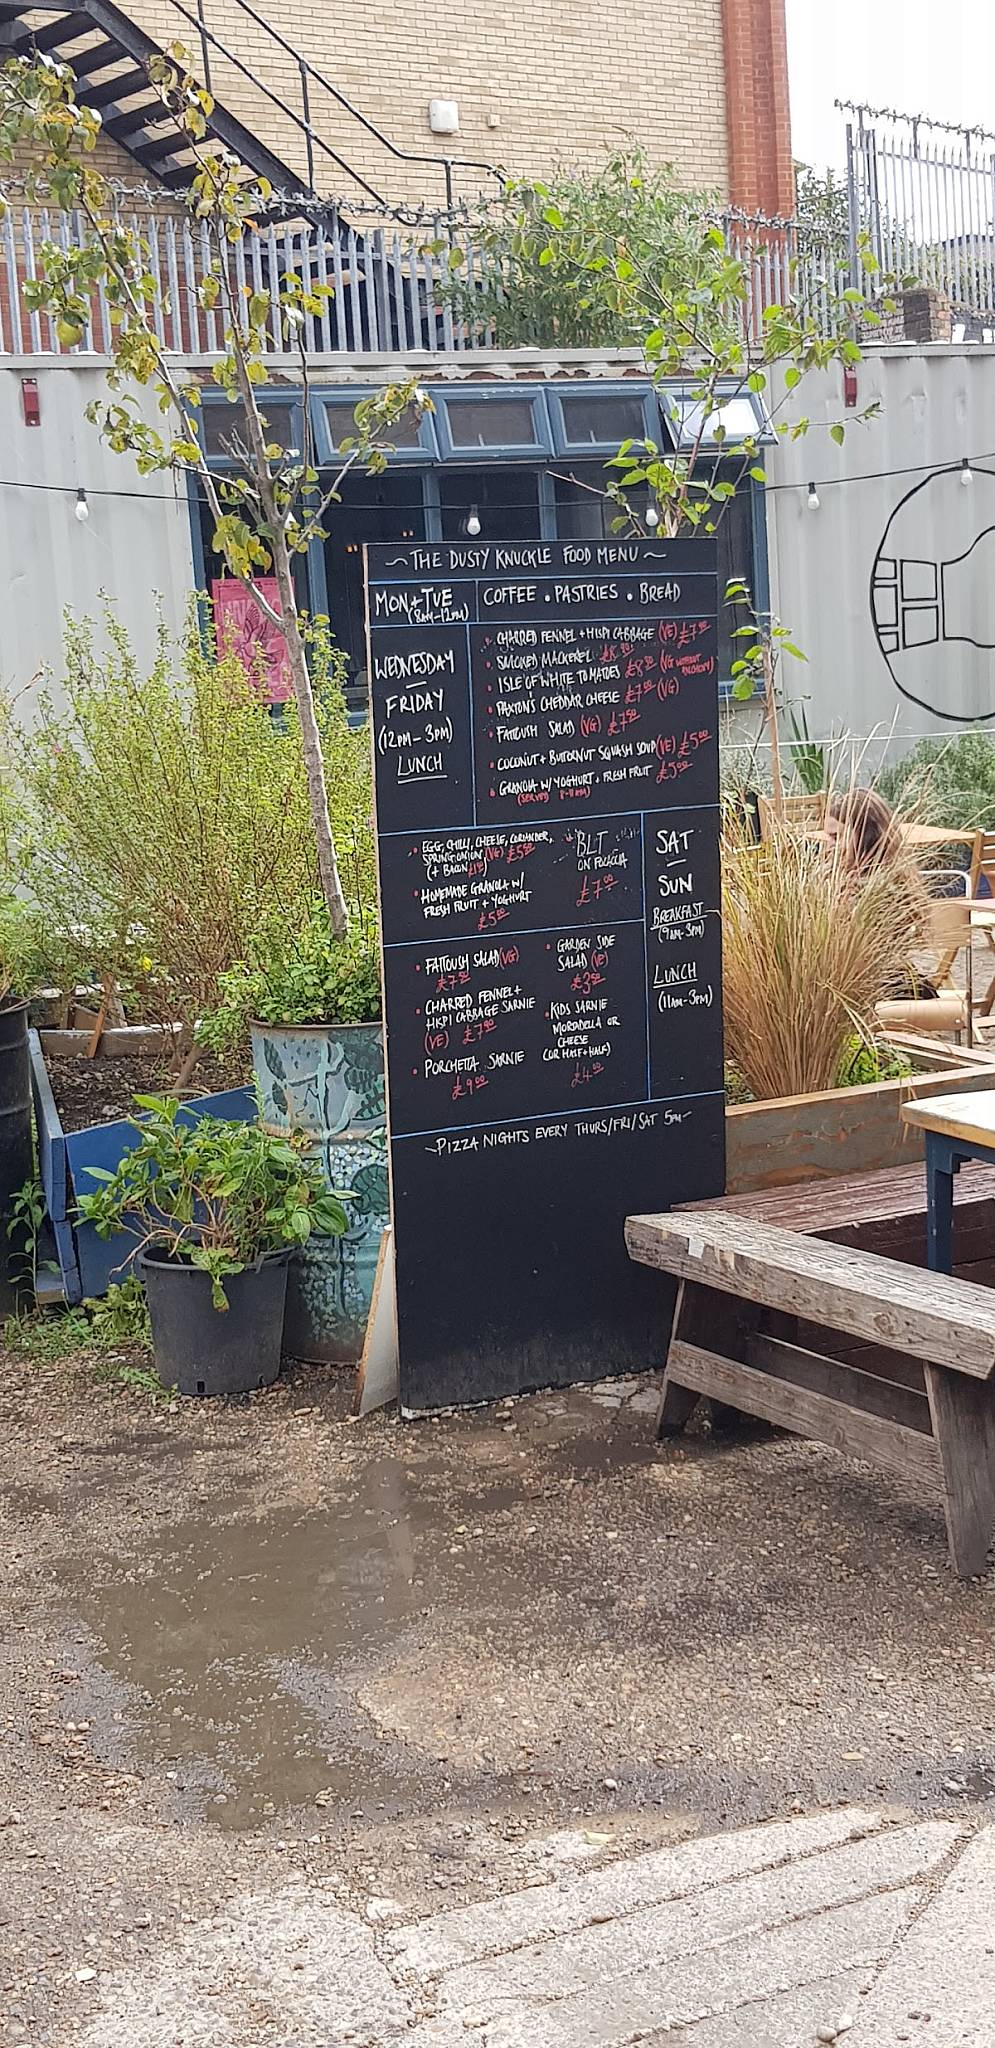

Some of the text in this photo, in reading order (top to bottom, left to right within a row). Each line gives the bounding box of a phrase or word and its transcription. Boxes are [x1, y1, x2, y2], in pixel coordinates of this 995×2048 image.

[409, 547, 638, 570] THE DUSTY KNUCKLE FOOD MENU
[483, 583, 681, 606] COFFEE PASTRIES BREAD
[496, 630, 537, 647] CHARRED
[541, 629, 577, 644] FENNEL
[612, 626, 655, 642] CABBAGE
[658, 620, 678, 644] (VE)
[375, 649, 454, 680] WEDNESDAY
[541, 648, 593, 669] MACKEREL
[498, 676, 523, 694] ISLE
[525, 676, 539, 690] OF
[541, 672, 575, 688] WHITE
[385, 688, 444, 719] FRIDAY
[540, 694, 584, 712] CHEDDAR
[586, 690, 621, 706] CHEESE
[657, 679, 680, 702] (VG)
[548, 719, 576, 738] SALAD
[580, 714, 602, 738] (VG)
[598, 742, 634, 761] SQUASH
[635, 740, 657, 756] SOUP
[397, 752, 443, 777] LUNCH
[499, 779, 539, 797] GRANOLA
[553, 771, 595, 790] YOGHURT
[602, 770, 627, 783] FRESH
[628, 764, 654, 780] FRUIT
[422, 840, 446, 854] EGG,
[475, 834, 508, 848] CHEESE,
[509, 830, 553, 845] CORIANDER,
[576, 830, 609, 858] BLT
[655, 830, 695, 855] SAT
[422, 851, 456, 868] SPRING
[456, 849, 483, 863] ONION
[443, 862, 469, 878] BACON
[577, 857, 592, 871] ON
[420, 884, 468, 906] HOMEMADE
[470, 879, 509, 898] GRANOLA
[657, 873, 694, 897] SUN
[423, 890, 532, 919] FRESH FRUIT + YOGHURT
[652, 902, 705, 927] BREAKFAST
[556, 935, 616, 953] GARDEN SIDE
[425, 945, 520, 976] FATTOUSH SALAD (VG)
[557, 951, 609, 972] SALAD (VE)
[653, 961, 698, 985] LUNCH
[425, 994, 474, 1016] CHARRED
[425, 997, 536, 1031] HISPI CABBAGE SARNIE
[550, 998, 608, 1020] KIDS SARNIE
[607, 1016, 621, 1026] OR
[424, 1030, 449, 1056] (VE)
[557, 1035, 589, 1048] CHEESE
[424, 1050, 525, 1078] PORCHETTA SARNIE
[435, 1138, 480, 1156] PIZZA
[483, 1130, 530, 1148] NIGHTS
[535, 1123, 568, 1139] EVERY
